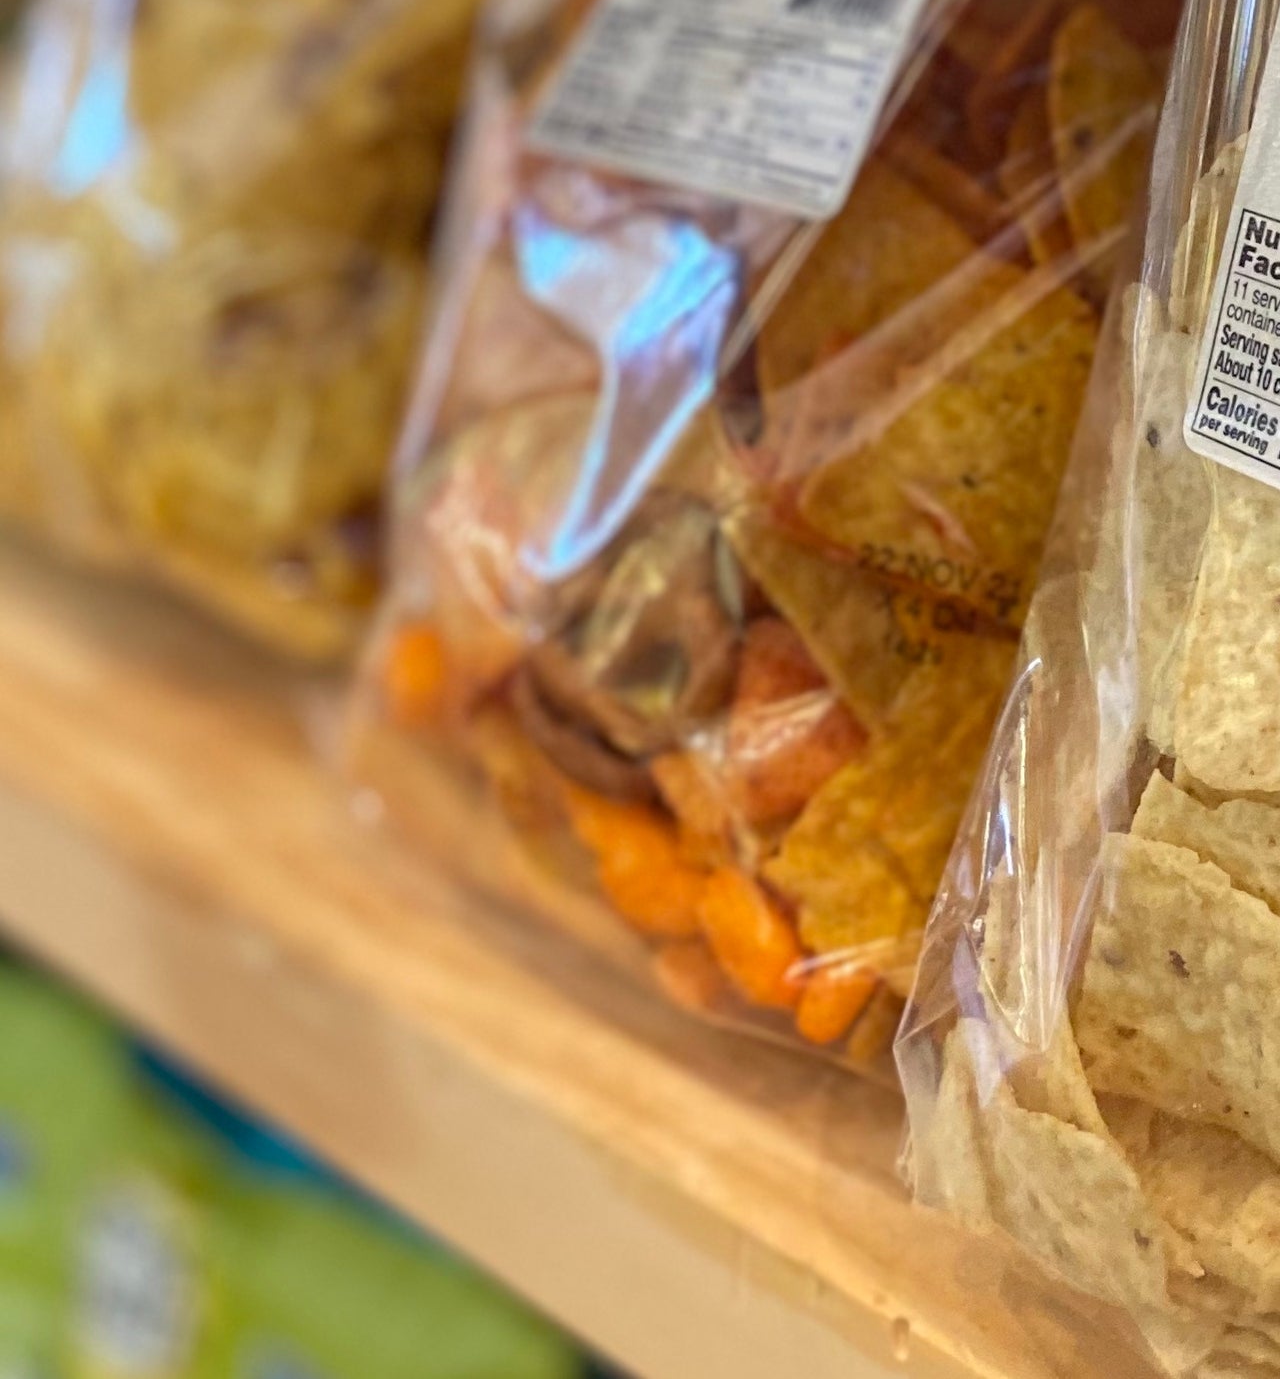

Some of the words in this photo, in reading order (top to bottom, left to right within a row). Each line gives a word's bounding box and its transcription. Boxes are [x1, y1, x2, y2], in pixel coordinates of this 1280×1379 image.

[1233, 279, 1249, 299] 11
[1220, 324, 1270, 365] Serving
[1214, 350, 1255, 379] About
[1256, 365, 1272, 391] 10
[1206, 385, 1279, 437] Calories
[1198, 413, 1222, 432] per
[1222, 423, 1269, 455] serving
